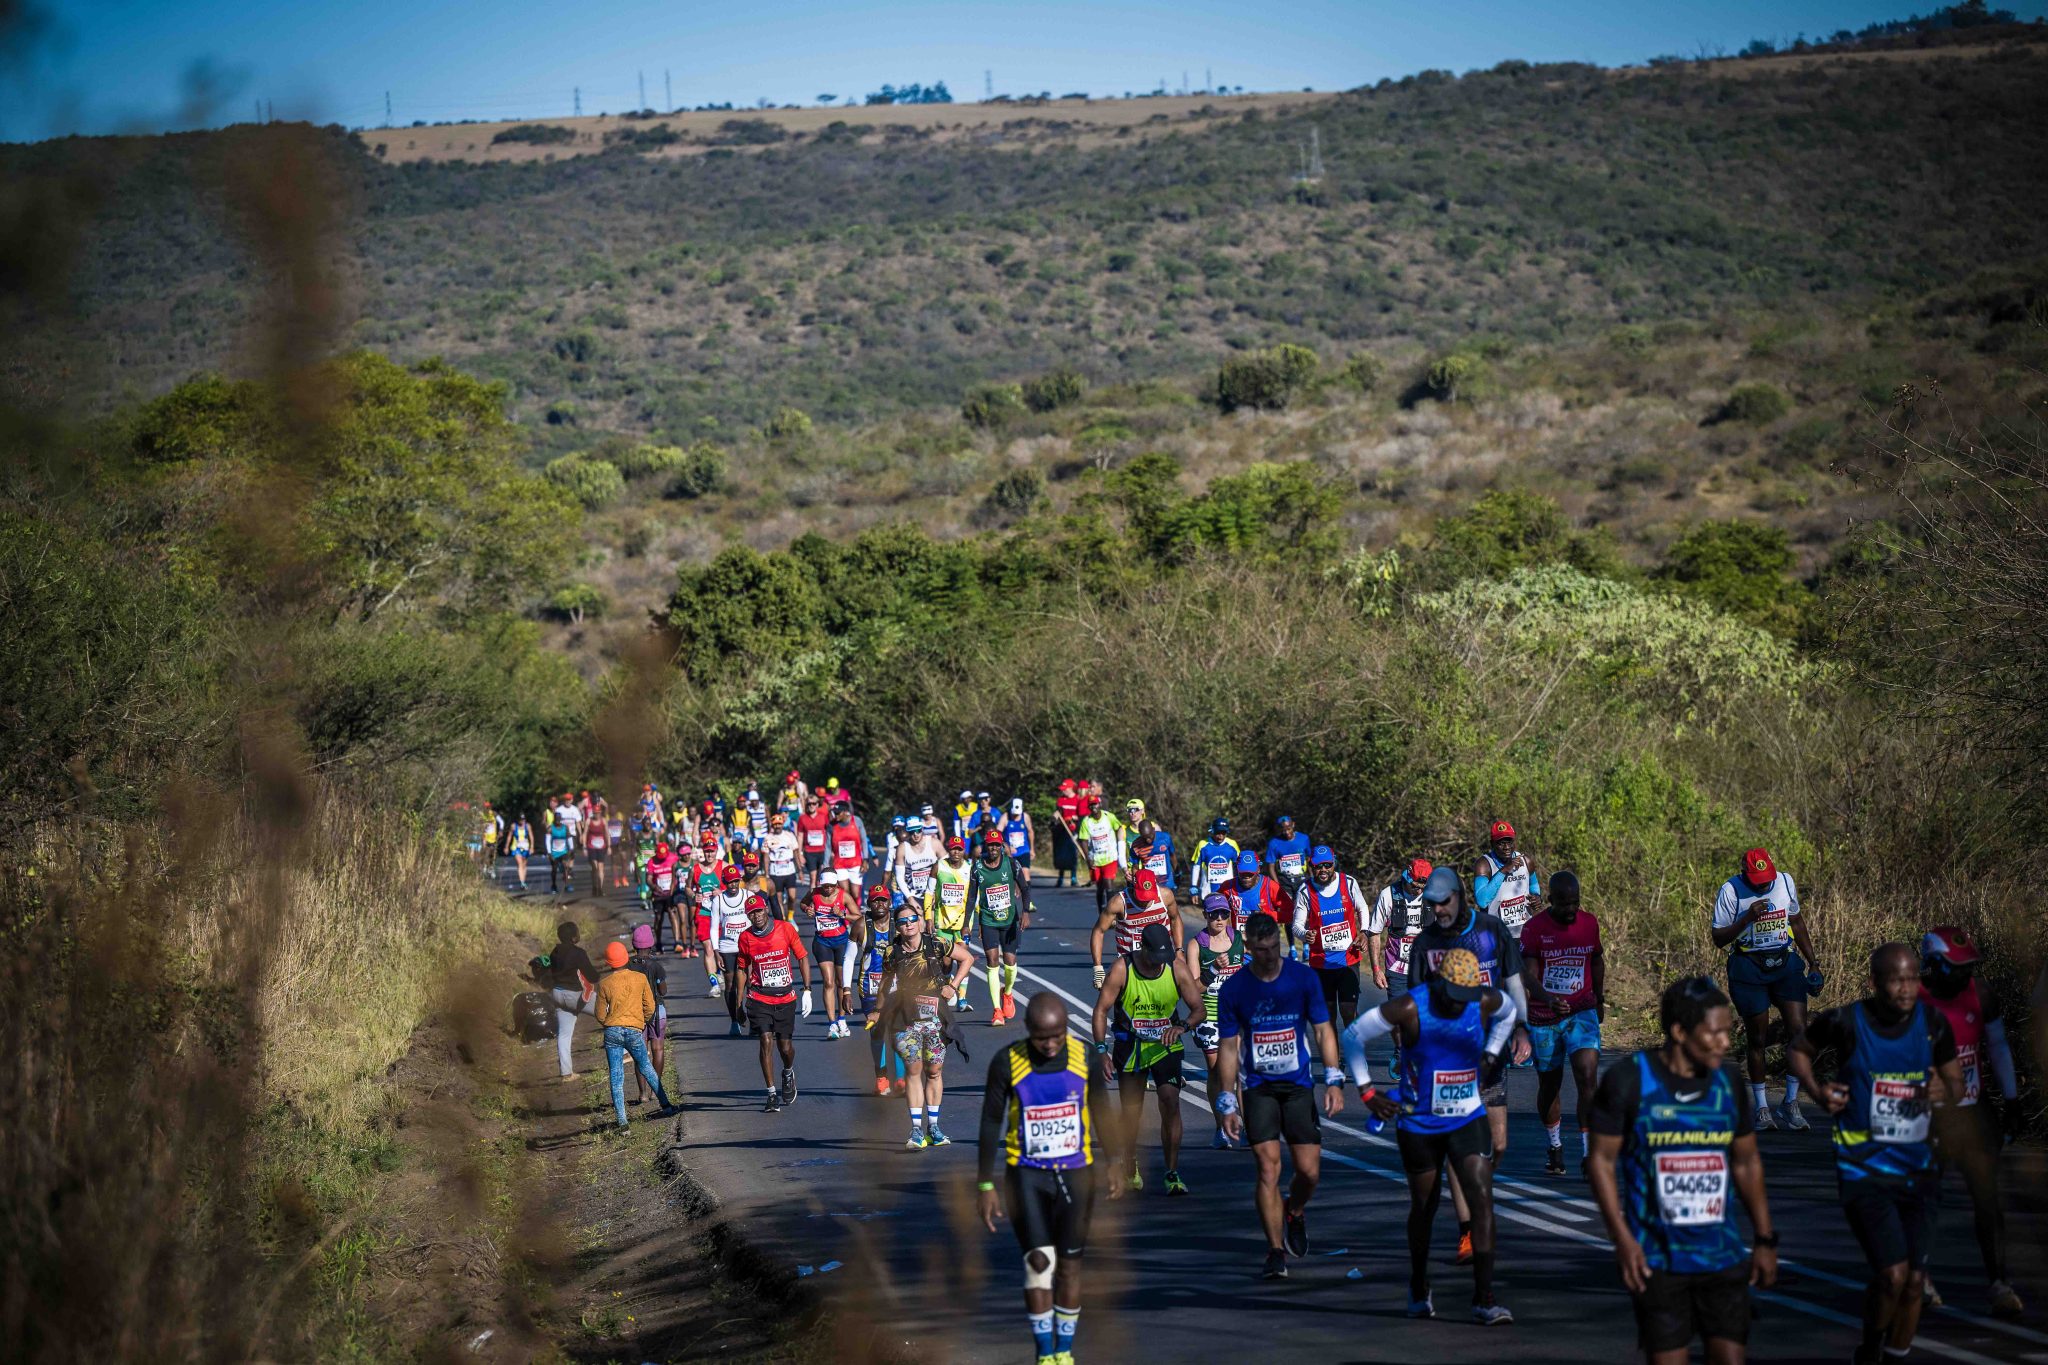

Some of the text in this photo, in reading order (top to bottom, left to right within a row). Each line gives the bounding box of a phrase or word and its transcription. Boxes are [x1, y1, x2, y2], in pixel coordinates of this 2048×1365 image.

[1755, 919, 1786, 933] D23345
[1324, 930, 1350, 943] C26841
[763, 967, 788, 979] C49003
[1548, 967, 1581, 979] F22574
[781, 977, 790, 986] 50
[1255, 1032, 1294, 1042] THIRSTI
[1257, 1042, 1295, 1058] C45189
[1031, 1119, 1075, 1137] D19254
[1664, 1175, 1722, 1194] D40629
